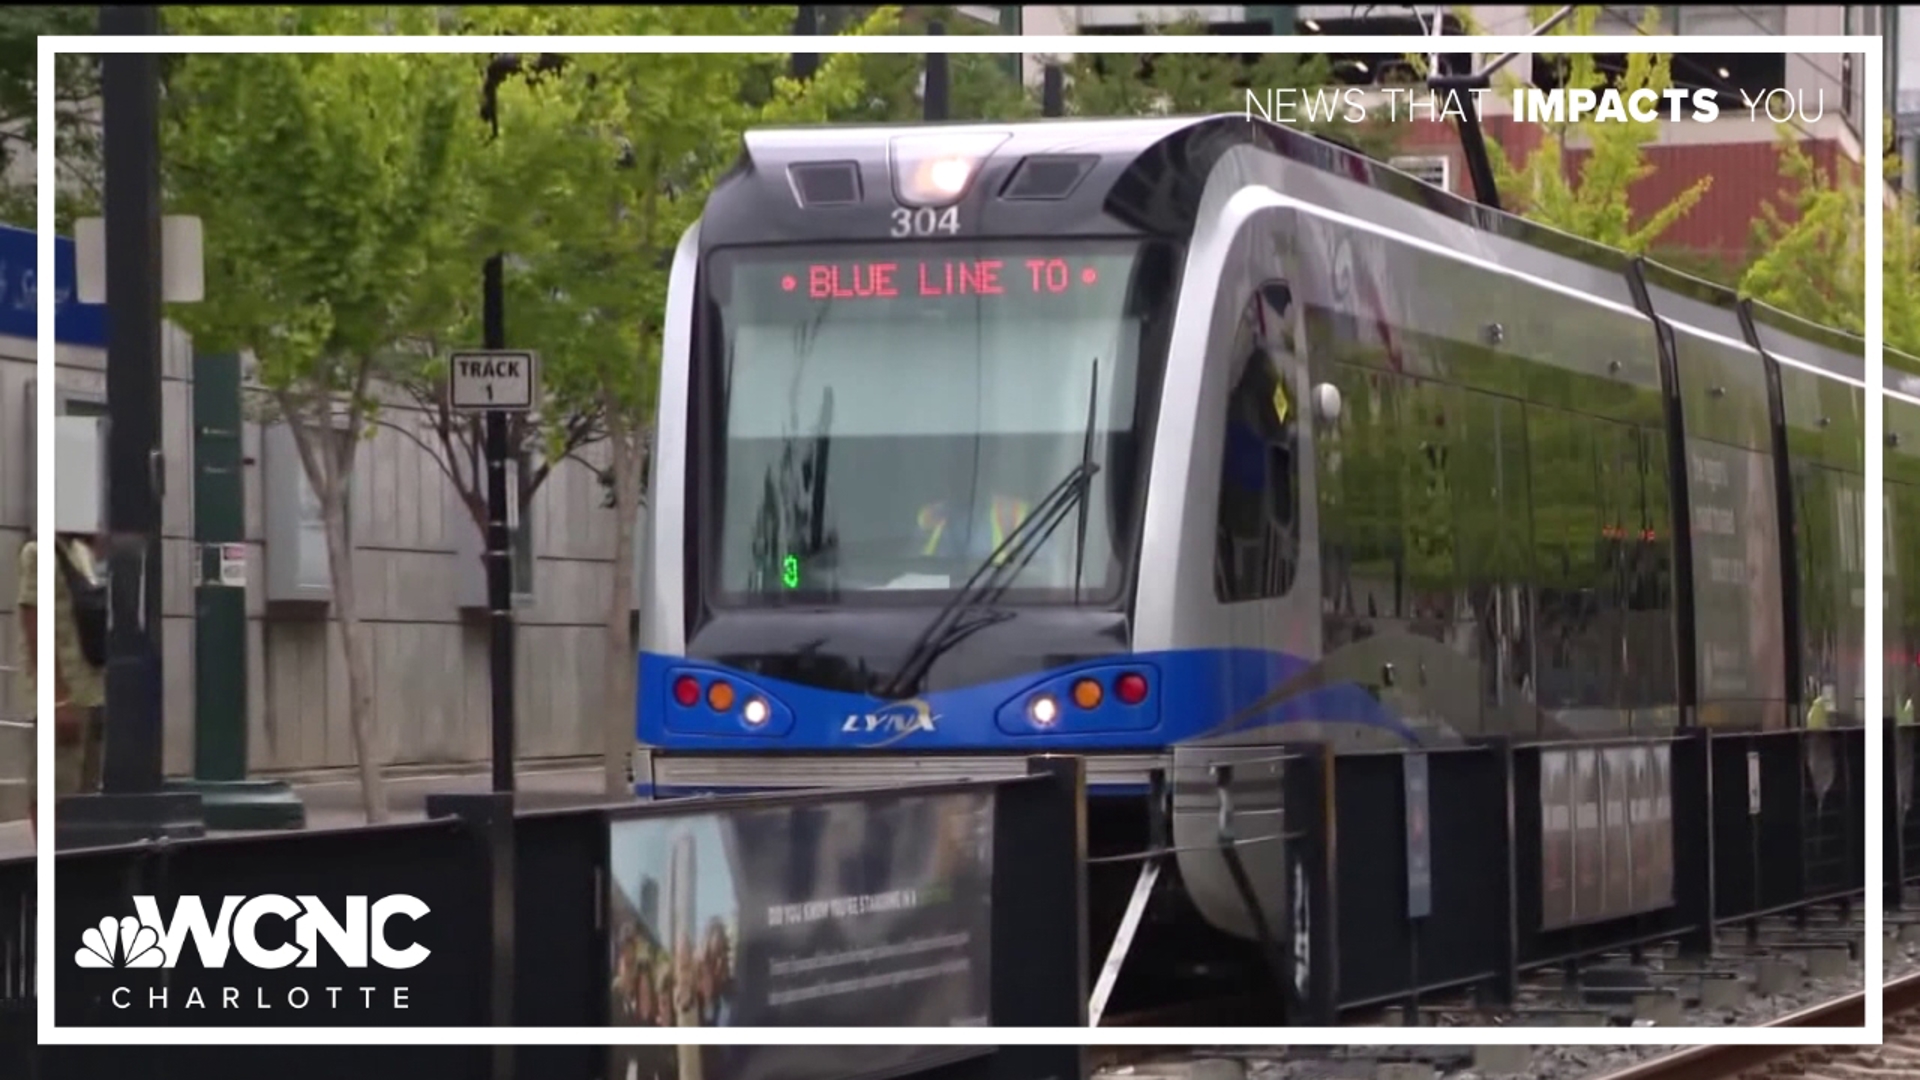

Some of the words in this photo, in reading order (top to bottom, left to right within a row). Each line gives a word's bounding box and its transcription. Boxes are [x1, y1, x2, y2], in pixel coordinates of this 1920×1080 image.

[890, 206, 961, 237] 304
[810, 263, 898, 297] BLUE
[919, 261, 1002, 296] LINE
[1025, 258, 1069, 293] TO
[459, 360, 519, 378] TRACK
[485, 383, 493, 401] 1
[842, 708, 943, 734] LYNX
